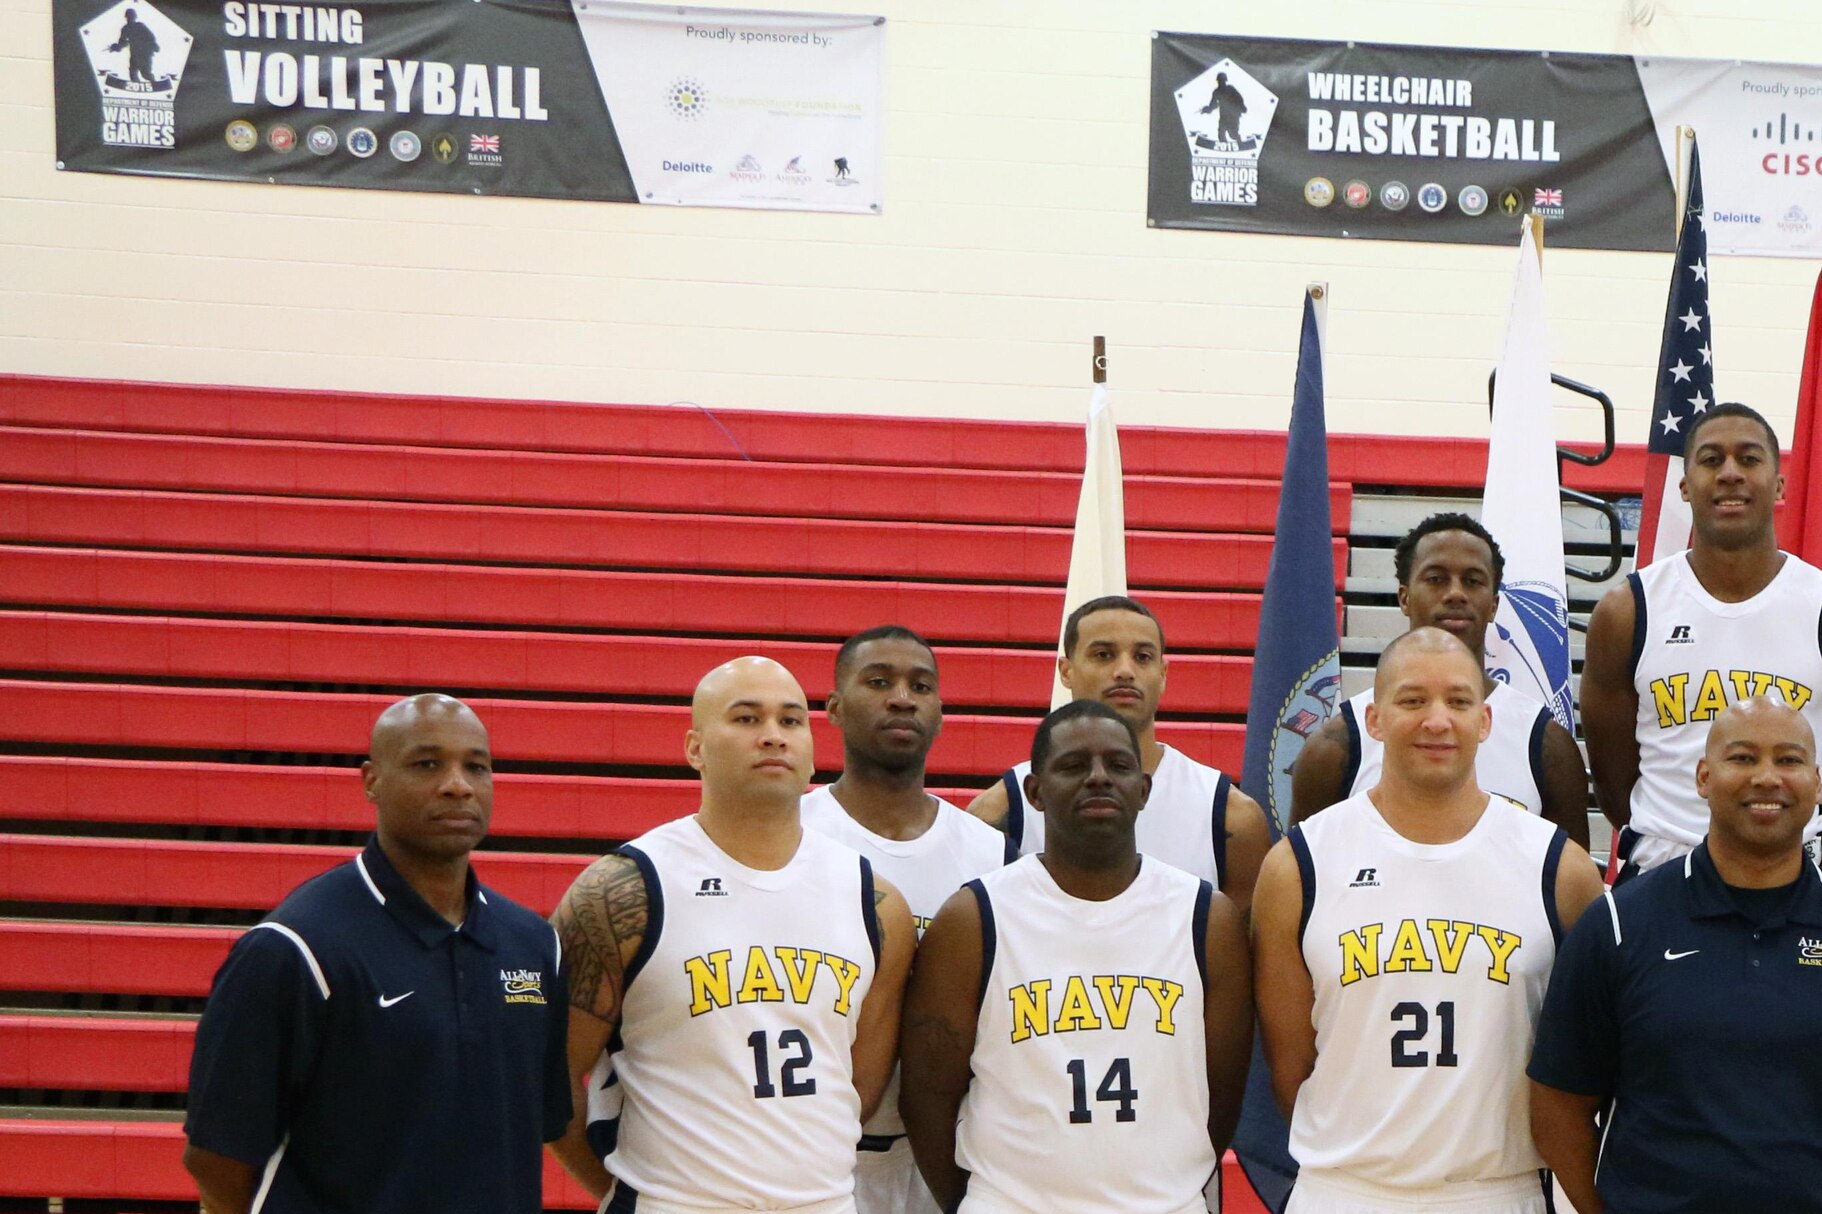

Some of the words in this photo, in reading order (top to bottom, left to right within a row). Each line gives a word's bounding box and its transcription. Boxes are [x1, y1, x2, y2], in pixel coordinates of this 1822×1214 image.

[224, 1, 364, 44] SITTING
[686, 26, 736, 43] Proudly
[740, 31, 809, 44] sponsored
[125, 81, 154, 92] 2015
[224, 50, 549, 121] VOLLEYBALL
[1308, 72, 1473, 107] WHEELCHAIR
[1742, 80, 1790, 97] Proudly
[103, 106, 175, 126] WARRIOR
[103, 121, 176, 147] GAMES
[1308, 108, 1561, 162] BASKETBALL
[662, 159, 713, 174] Deloitte
[1191, 165, 1258, 183] WARRIOR
[1190, 180, 1258, 203] GAMES
[1713, 211, 1761, 224] Deloitte
[1671, 625, 1691, 639] R
[700, 878, 722, 891] R
[1355, 868, 1377, 882] R
[1339, 919, 1521, 987] NAVY
[685, 945, 861, 1017] NAVY
[504, 994, 547, 1004] BASKETBALL
[1009, 975, 1184, 1044] NAVY
[1391, 1002, 1458, 1068] 21
[748, 1029, 816, 1098] 12
[1067, 1058, 1138, 1123] 14
